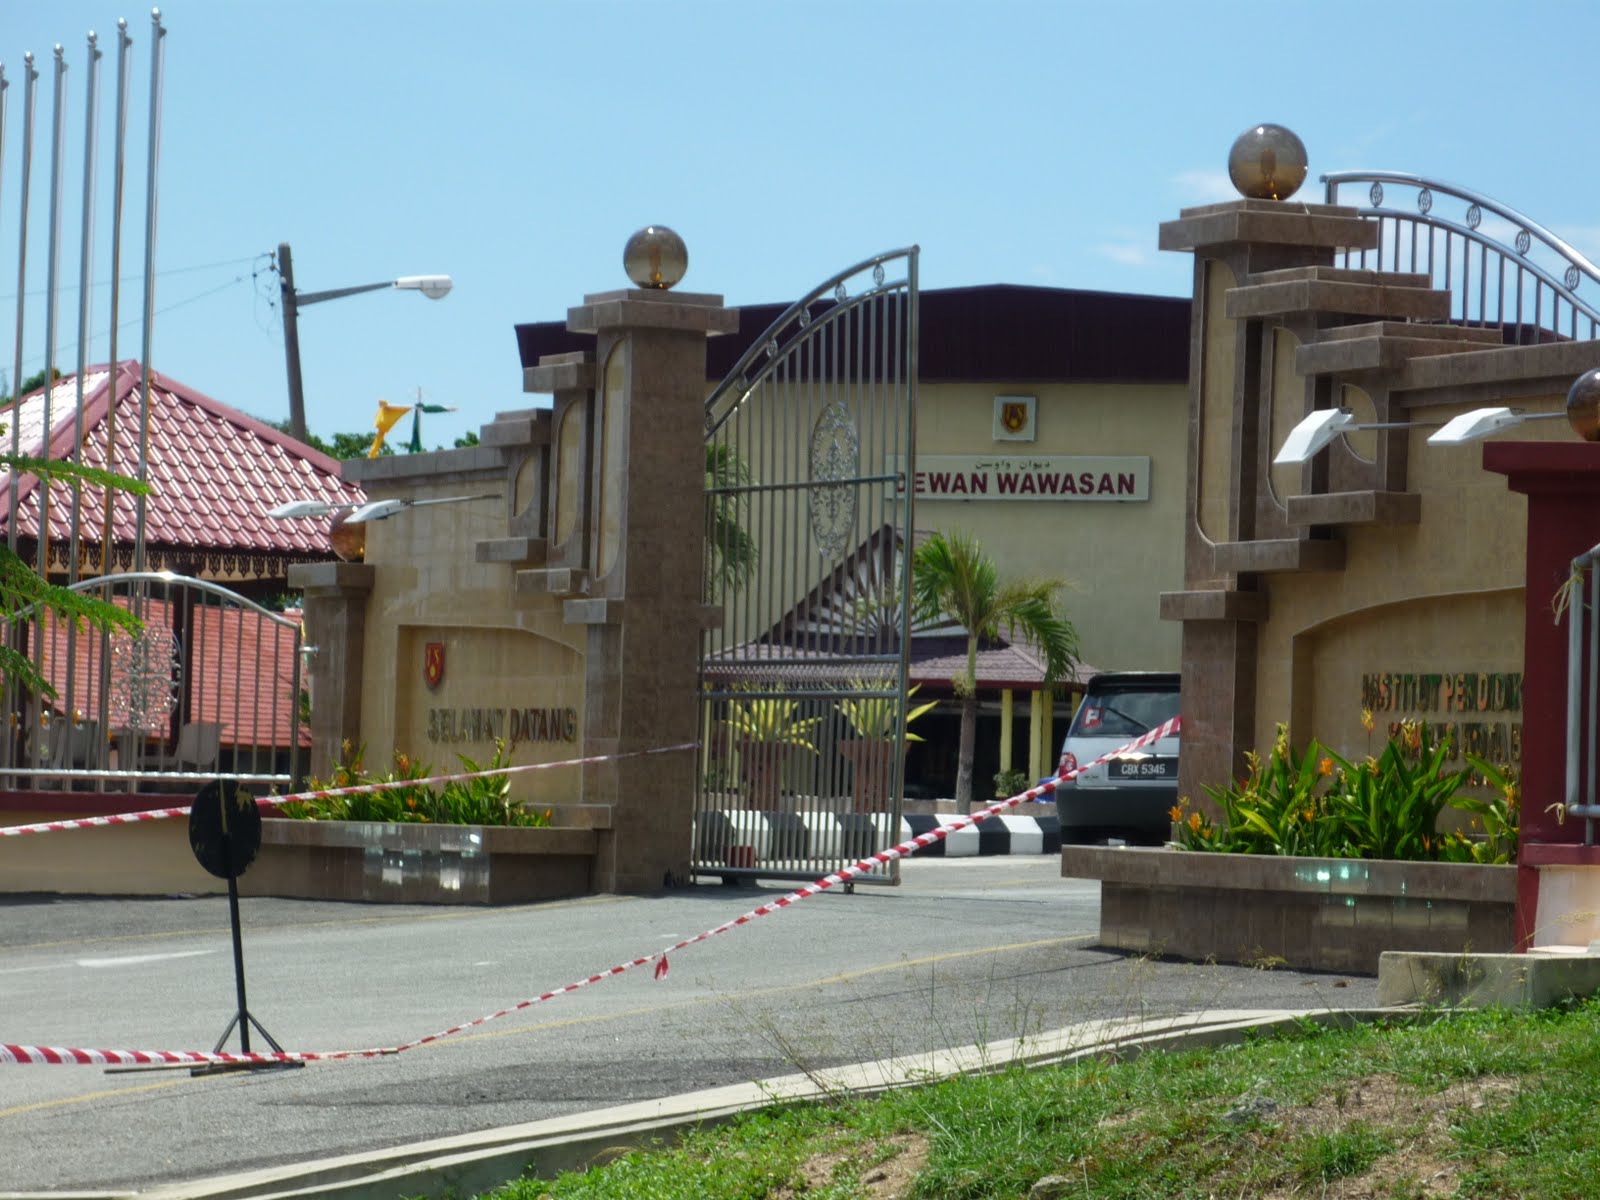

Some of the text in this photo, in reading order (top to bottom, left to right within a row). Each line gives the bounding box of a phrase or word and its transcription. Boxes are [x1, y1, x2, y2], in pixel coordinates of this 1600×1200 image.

[996, 473, 1135, 495] WAWASAN
[428, 708, 577, 743] SELAMAT DATANG
[1085, 708, 1100, 725] P
[1121, 763, 1166, 775] CBX 5345
